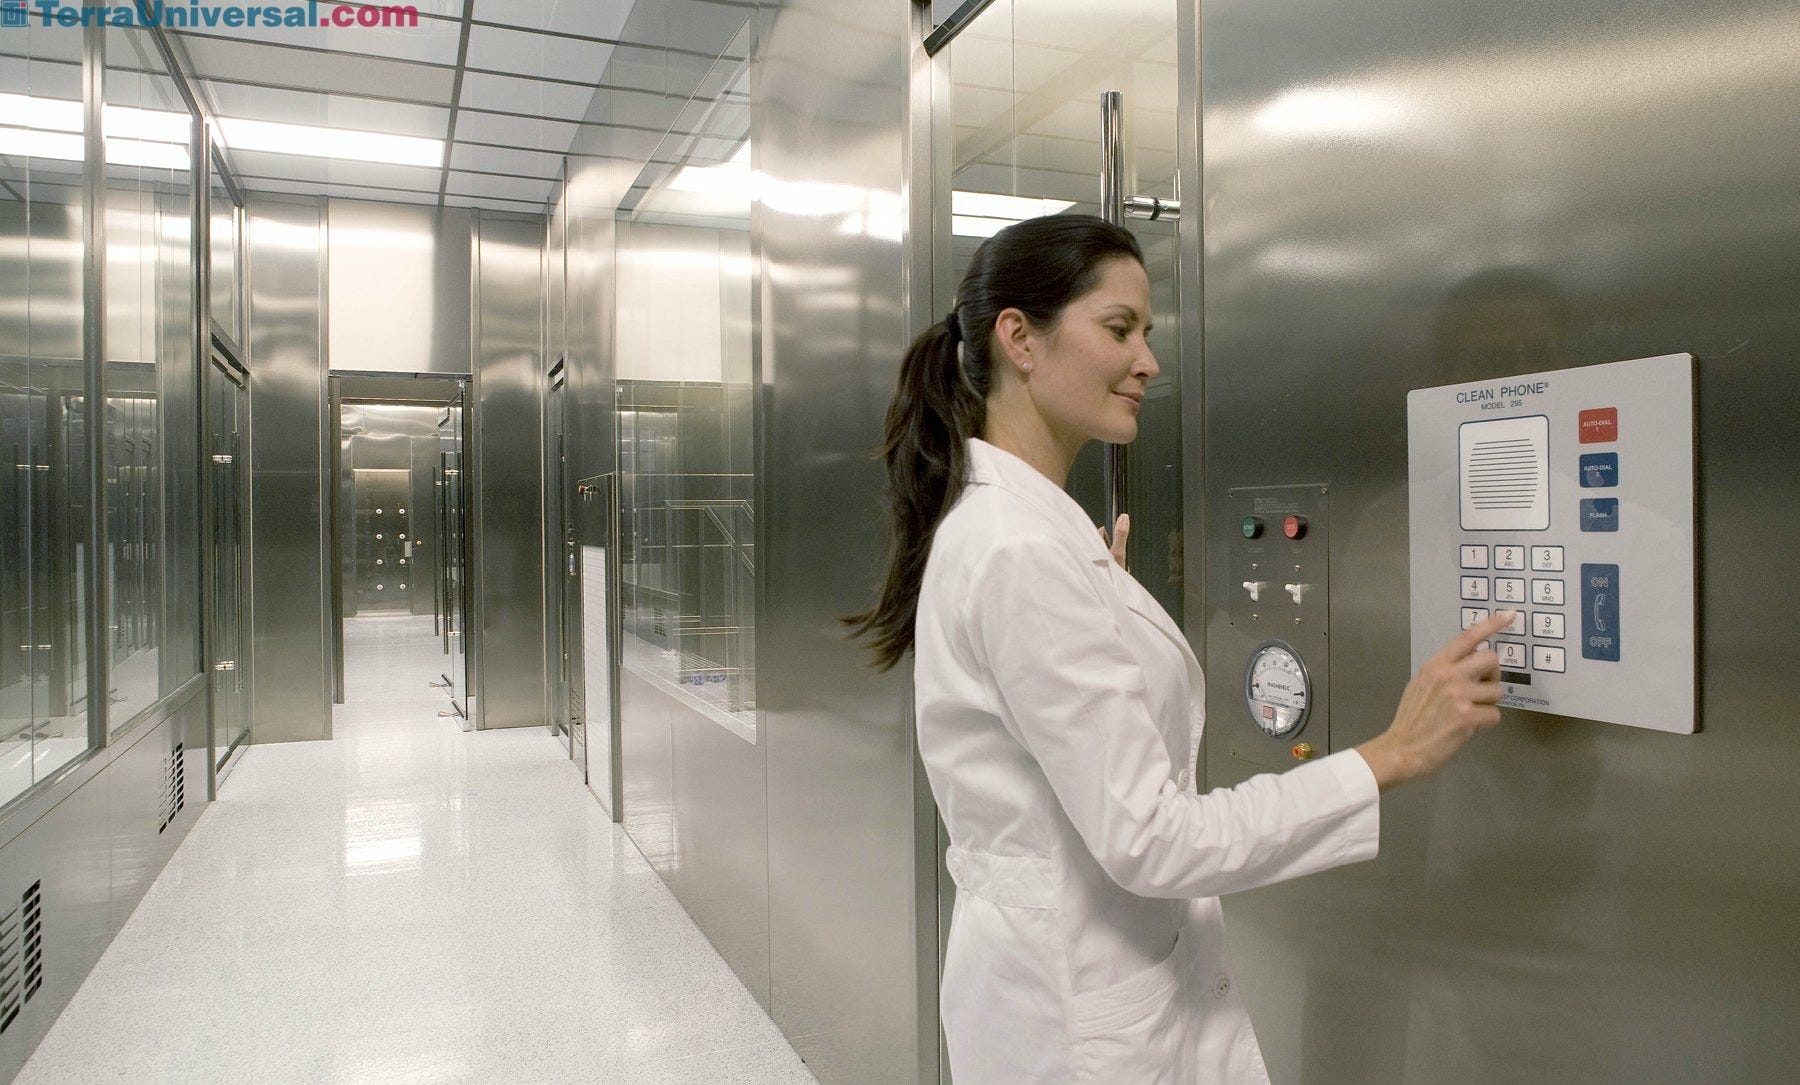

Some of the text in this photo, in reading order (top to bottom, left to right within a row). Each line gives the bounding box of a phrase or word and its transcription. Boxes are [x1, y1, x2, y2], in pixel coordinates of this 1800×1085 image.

[1456, 389, 1494, 404] CLEAN
[1481, 400, 1523, 410] MODEL 295
[1505, 549, 1512, 560] 2
[1543, 550, 1551, 561] 3
[1471, 580, 1477, 590] 4
[1506, 581, 1513, 592] 5
[1590, 576, 1609, 588] ON
[1544, 583, 1552, 595] 6
[1472, 611, 1478, 622] 7
[1544, 616, 1552, 628] 9
[1589, 636, 1612, 648] OFF
[1507, 646, 1514, 657] 0
[1545, 653, 1552, 665] #
[1510, 695, 1550, 706] CORPORATION
